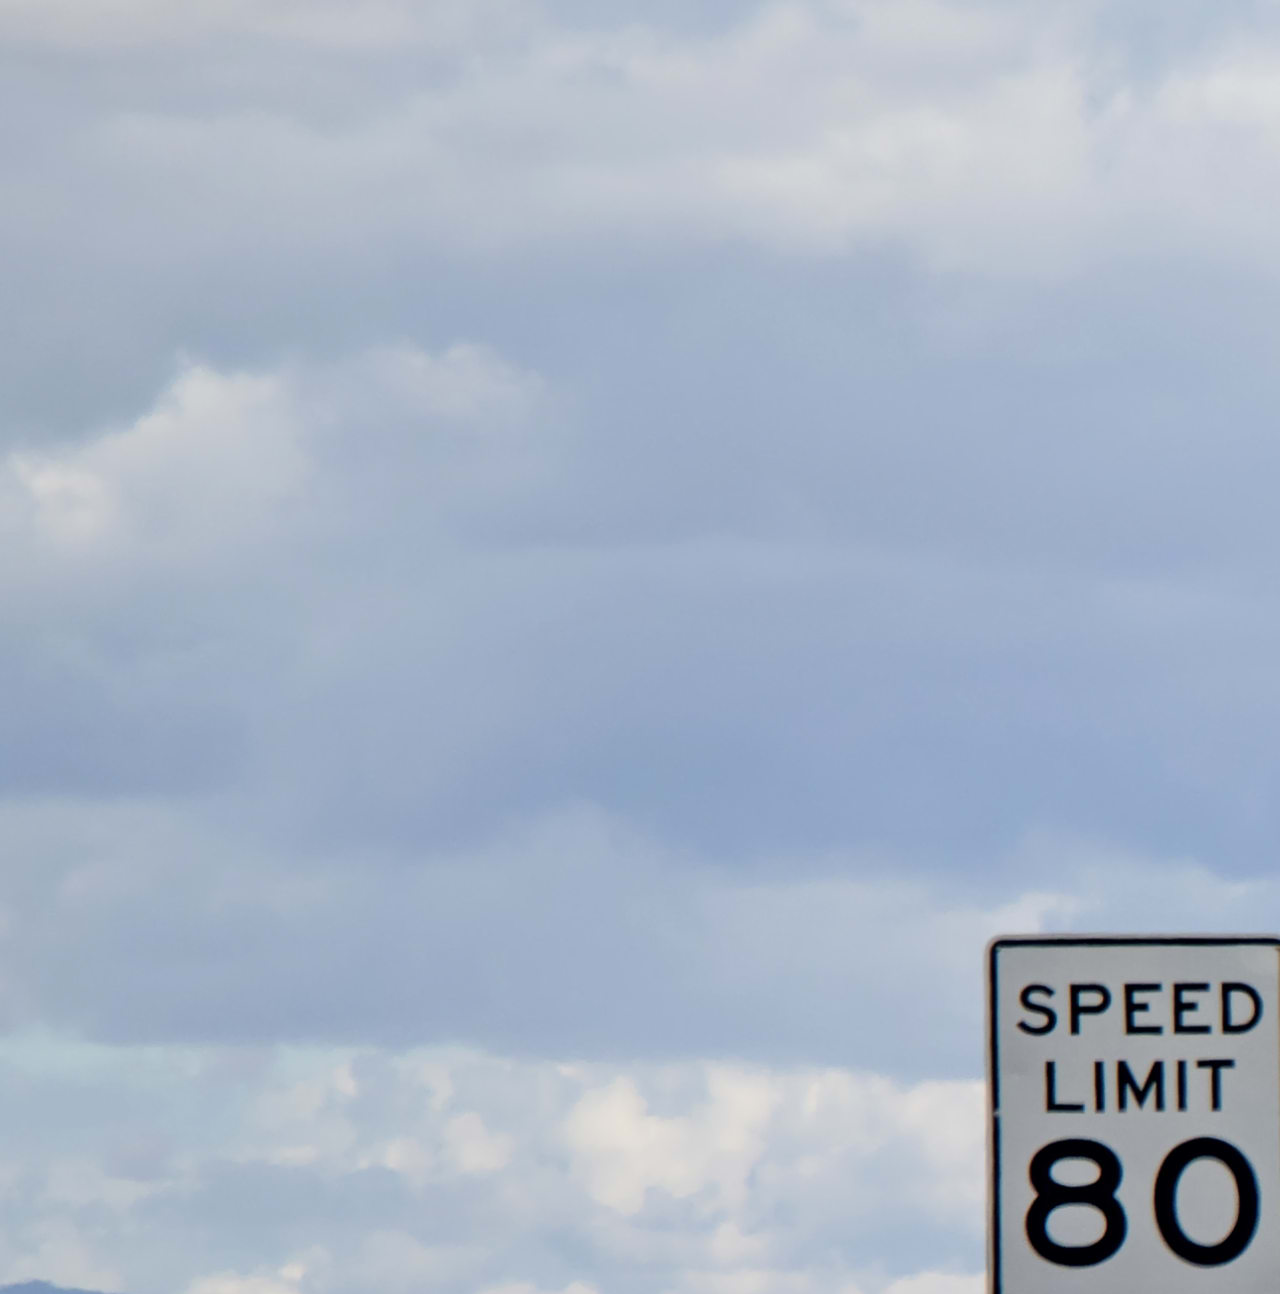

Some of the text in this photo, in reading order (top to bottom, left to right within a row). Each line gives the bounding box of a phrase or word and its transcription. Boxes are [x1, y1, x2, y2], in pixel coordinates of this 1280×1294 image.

[1016, 981, 1264, 1037] SPEED
[1044, 1058, 1236, 1114] LIMIT
[1024, 1136, 1261, 1269] 80
